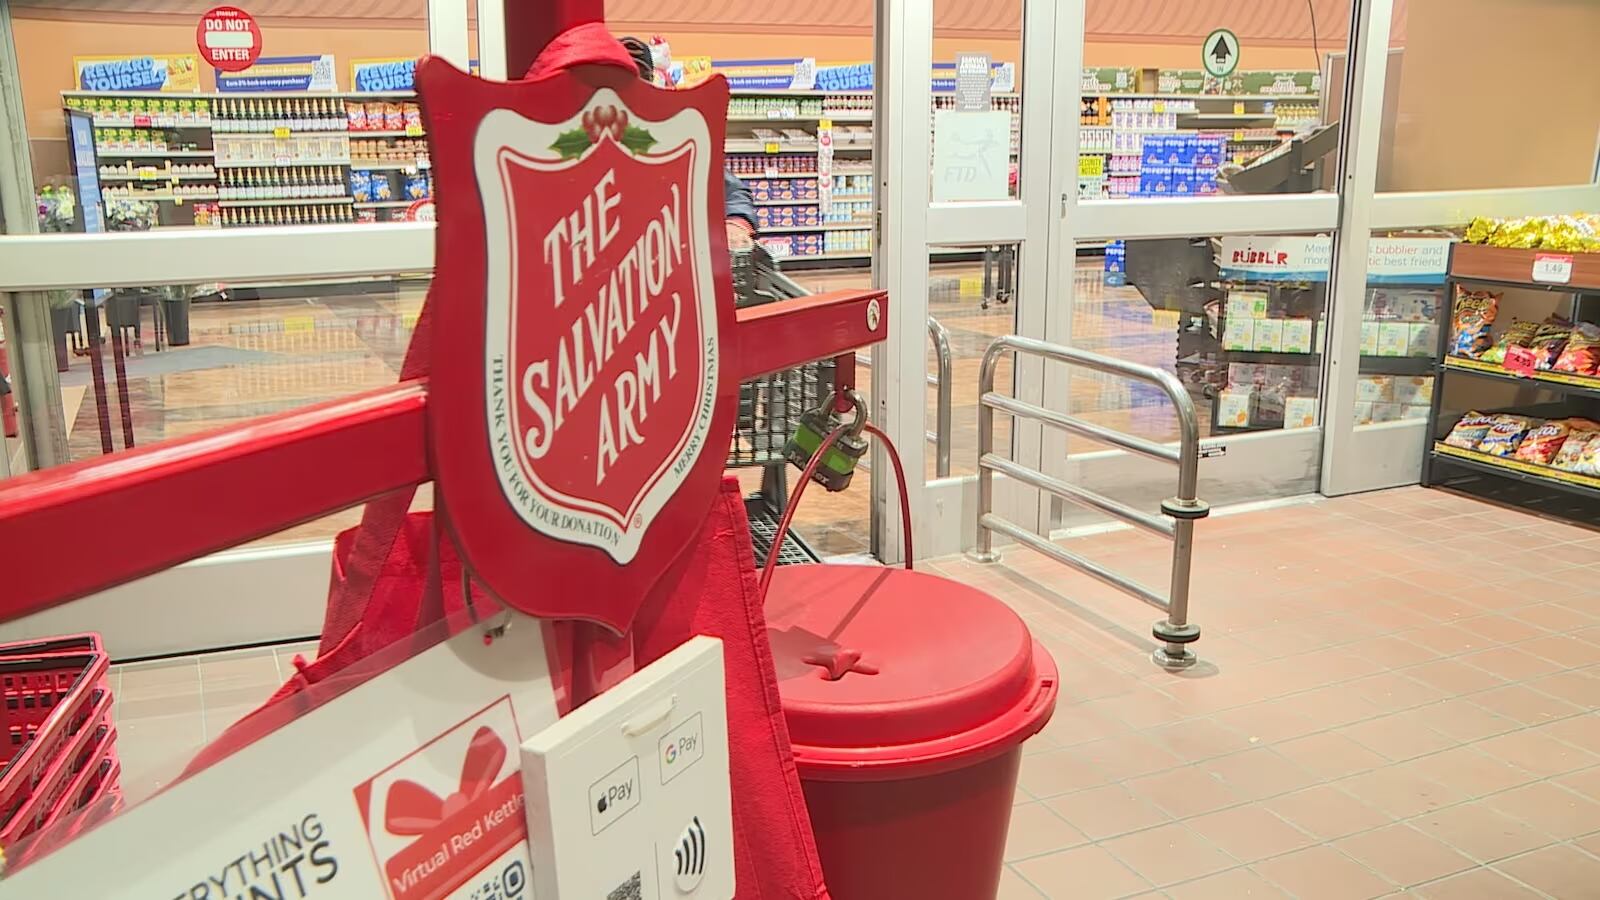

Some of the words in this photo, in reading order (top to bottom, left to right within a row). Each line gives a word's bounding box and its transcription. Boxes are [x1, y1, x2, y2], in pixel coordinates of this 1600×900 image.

[205, 19, 223, 31] DO
[225, 19, 251, 31] NOT
[84, 56, 155, 80] REWARD
[211, 48, 250, 61] ENTER
[86, 67, 168, 91] YOURSELF
[359, 60, 415, 80] REWAR
[360, 72, 414, 92] YOURS
[816, 64, 873, 81] REWAR
[543, 168, 623, 309] THE
[1375, 244, 1418, 255] bubblier
[1422, 245, 1443, 255] and
[1383, 255, 1408, 266] best
[1410, 255, 1442, 266] friend
[522, 182, 683, 460] SALVATION
[492, 353, 508, 430] THANK
[596, 292, 681, 487] ARMY
[672, 434, 702, 479] MERRY
[698, 336, 715, 431] CHRISTMAS
[495, 430, 515, 472] YOU
[508, 470, 530, 505] FOR
[529, 498, 561, 527] YOUR
[560, 515, 622, 547] DONATION
[679, 732, 698, 756] Pay
[608, 778, 633, 807] Pay
[172, 813, 323, 900] RYTHING
[236, 840, 339, 900] NTS
[393, 843, 451, 893] Virtual
[450, 822, 484, 856] Red
